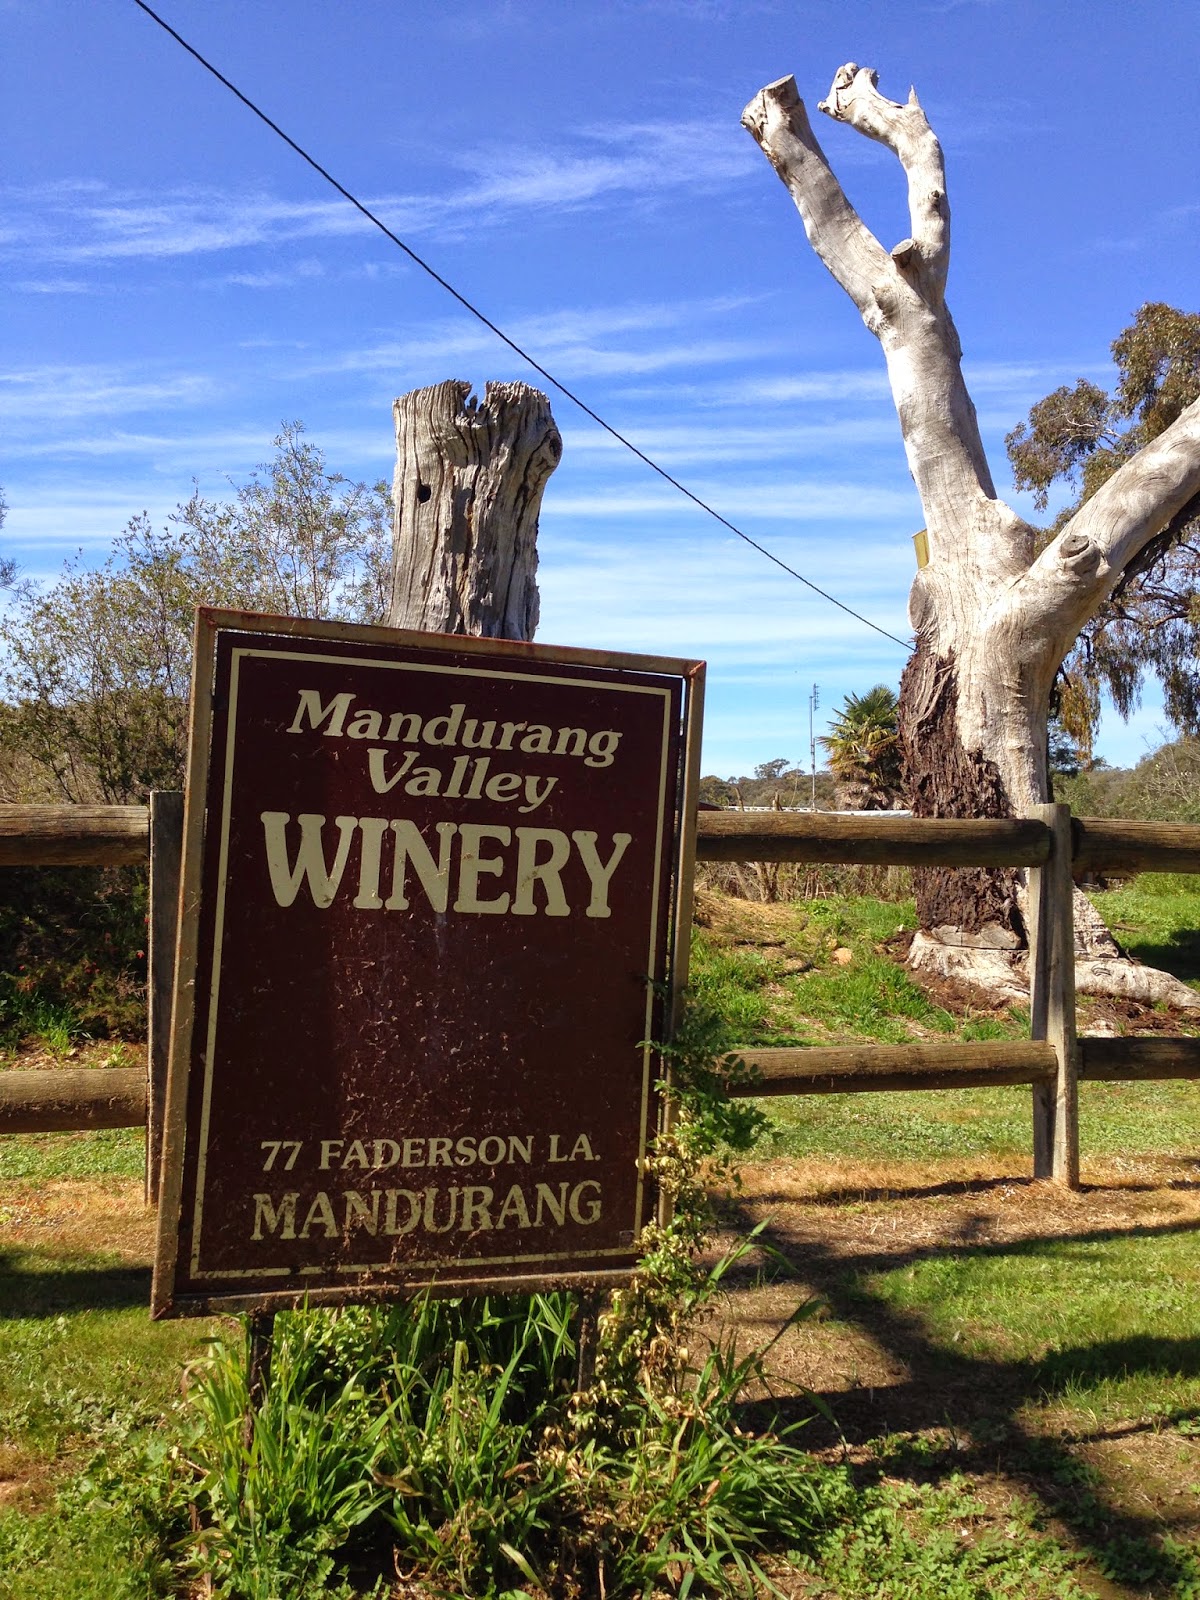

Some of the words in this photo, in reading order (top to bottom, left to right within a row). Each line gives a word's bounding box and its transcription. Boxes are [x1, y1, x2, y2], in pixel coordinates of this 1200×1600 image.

[286, 689, 623, 768] Mandurang
[366, 748, 559, 813] Valley
[260, 810, 632, 918] WINERY
[260, 1141, 303, 1172] 77
[318, 1135, 535, 1170] FADERSON
[547, 1133, 601, 1163] LA.
[249, 1180, 602, 1241] MANDURANG
